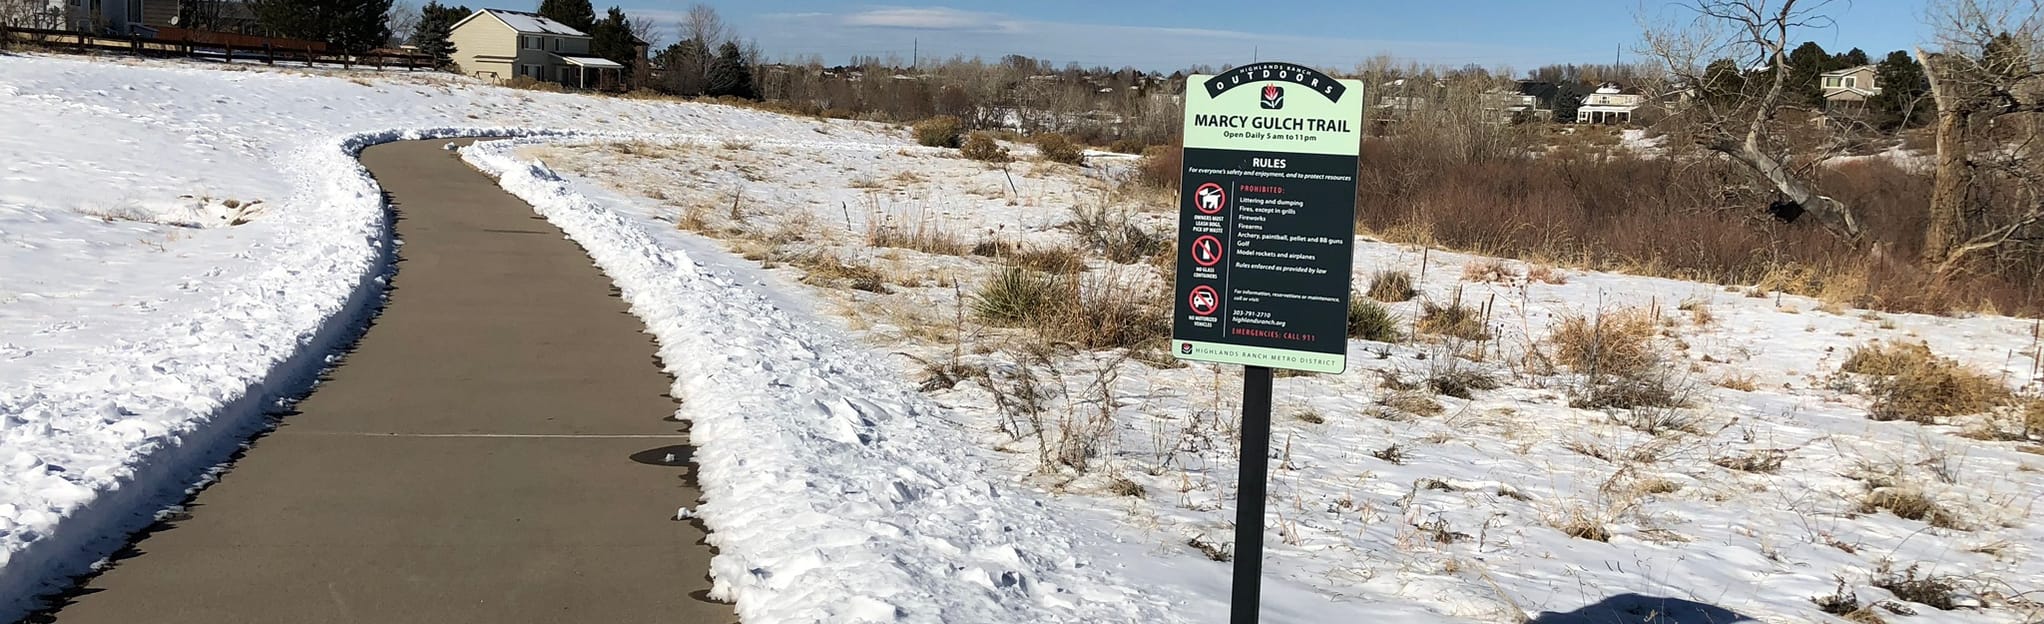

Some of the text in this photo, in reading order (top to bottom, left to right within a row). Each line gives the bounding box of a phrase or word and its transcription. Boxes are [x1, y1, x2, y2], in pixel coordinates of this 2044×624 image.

[1240, 64, 1311, 75] HIGHLANDS RANCH
[1216, 70, 1333, 94] OUTDOORS
[1194, 114, 1350, 132] MARCY GULCH TRAIL
[1224, 130, 1244, 138] Open
[1246, 132, 1264, 140] Daily
[1252, 158, 1286, 168] RULES
[1240, 184, 1285, 194] PROHIBITED:
[1240, 197, 1264, 205] Littering
[1277, 199, 1303, 207] dumping
[1283, 265, 1308, 273] provided
[1232, 316, 1286, 327] highlandsranch.org
[1232, 328, 1280, 338] EMERGENCIES:
[1284, 332, 1299, 340] CALL
[1196, 348, 1238, 356] HIGHLANDS
[1300, 357, 1335, 366] DISTRICT
